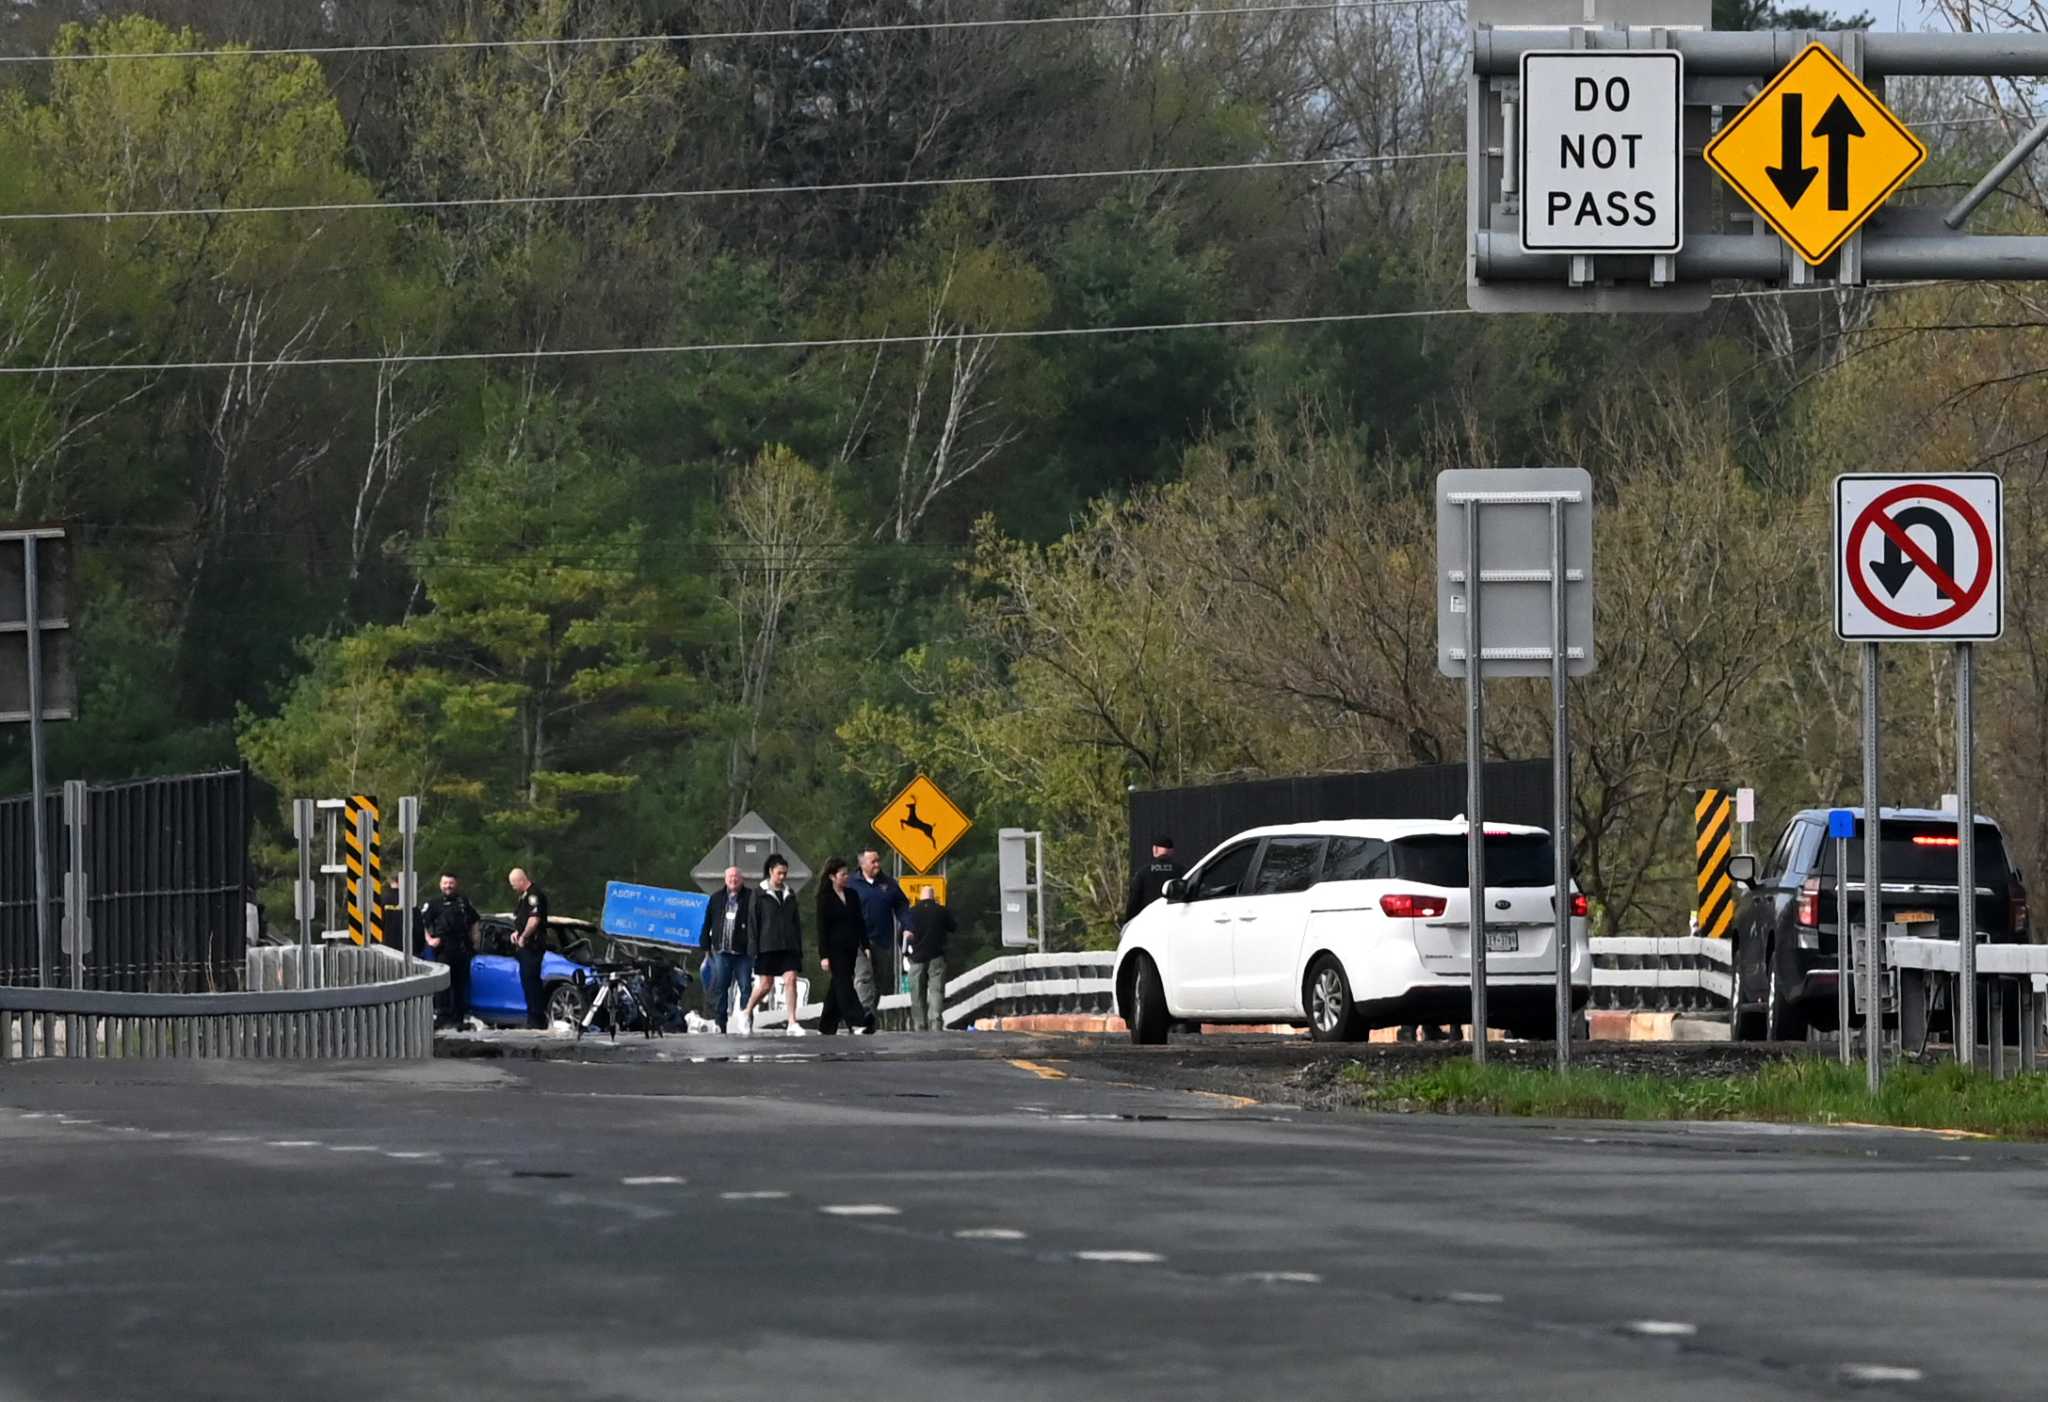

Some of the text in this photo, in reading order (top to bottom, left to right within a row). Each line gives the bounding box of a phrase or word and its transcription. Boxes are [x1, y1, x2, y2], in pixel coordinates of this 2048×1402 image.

[1574, 76, 1630, 112] DO
[1560, 133, 1643, 169] NOT
[1547, 190, 1657, 227] PASS
[1150, 863, 1173, 872] POLICE
[611, 888, 642, 899] ADOPT
